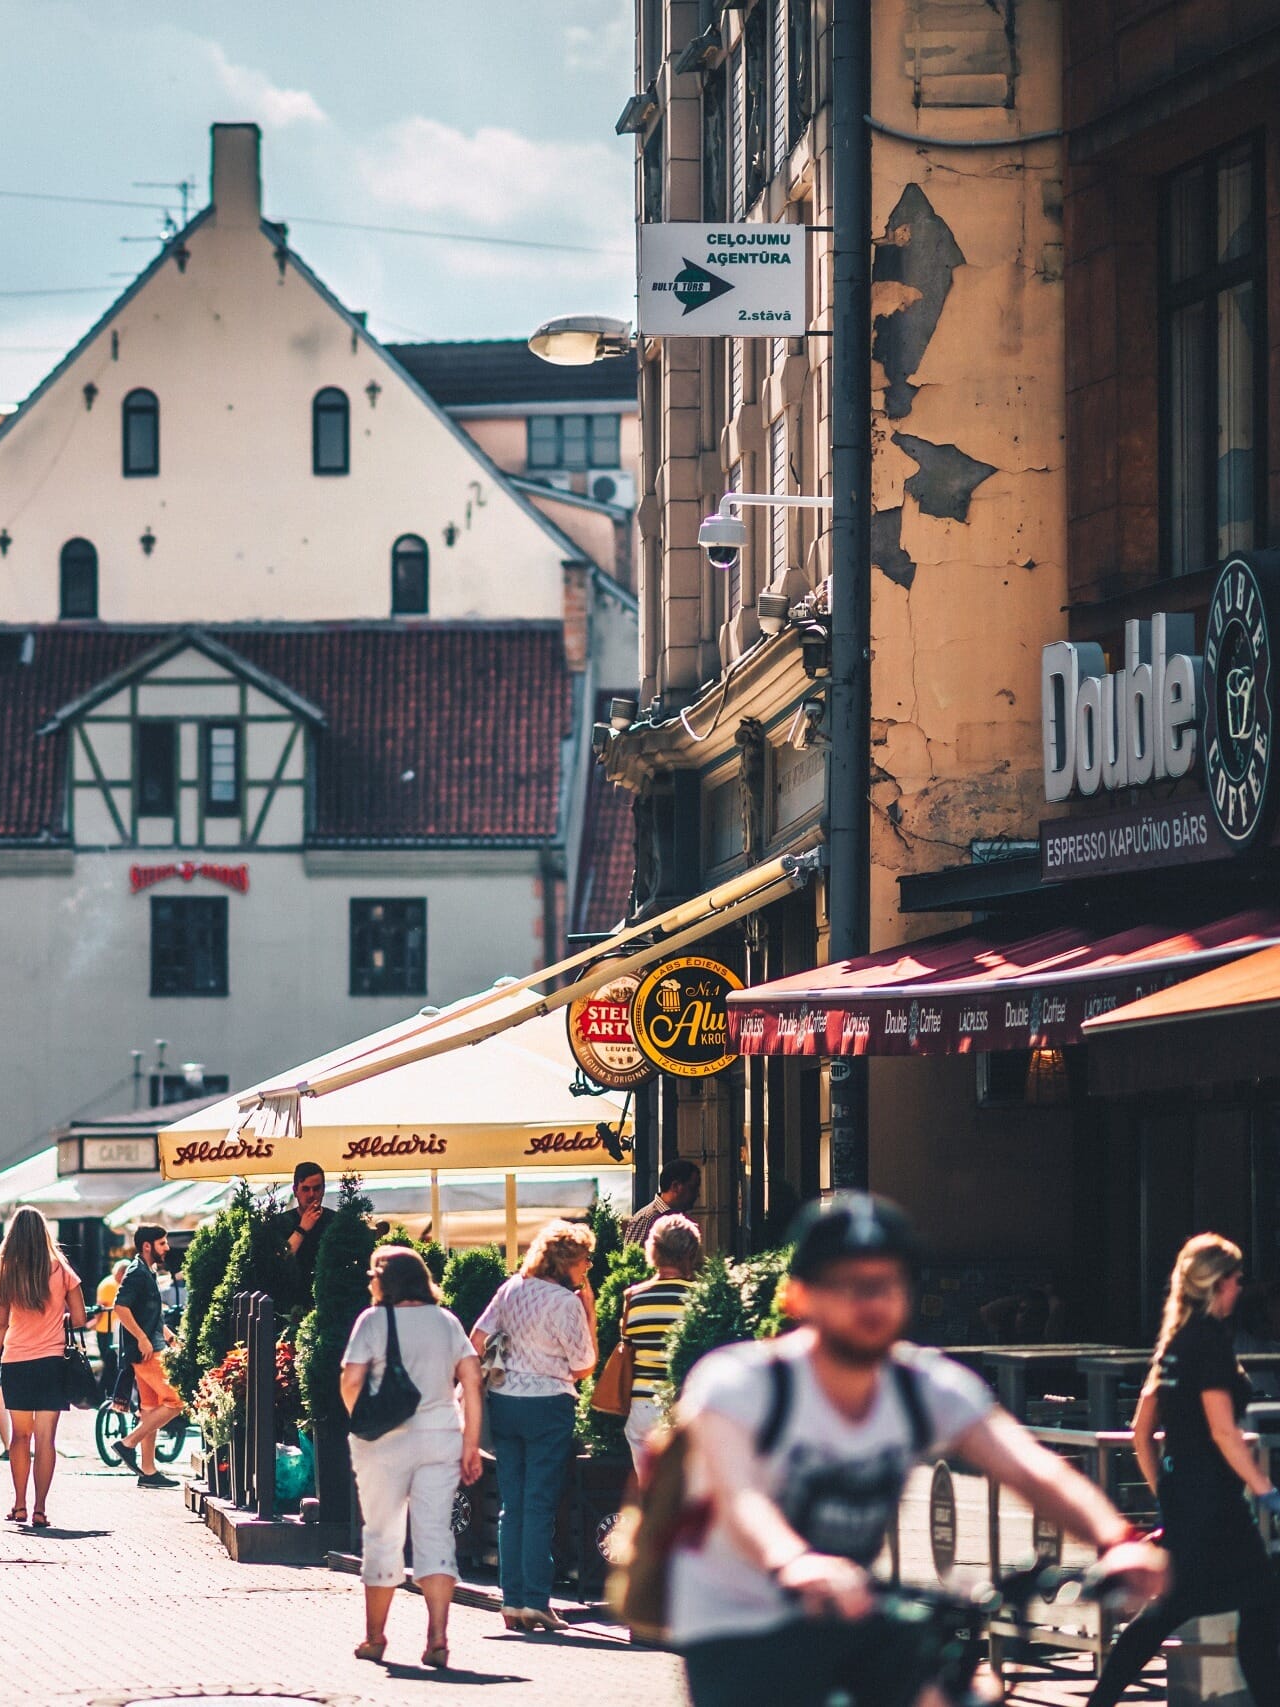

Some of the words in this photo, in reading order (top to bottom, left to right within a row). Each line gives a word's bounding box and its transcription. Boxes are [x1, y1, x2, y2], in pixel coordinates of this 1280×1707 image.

[706, 234, 791, 247] CEĻOJUMU
[706, 251, 791, 266] AĢENTŪRA
[652, 282, 678, 291] BULTA
[683, 281, 704, 291] TŪRS
[738, 310, 791, 321] 2.stāvā
[1207, 571, 1265, 673] DOUBLE
[1042, 612, 1196, 803] Double
[1208, 722, 1268, 827] COFFEE
[1047, 831, 1107, 867] ESPRESSO
[1109, 817, 1170, 858] KAPUČĪNO
[1173, 812, 1208, 847] BĀRS
[653, 961, 681, 980] LABS
[686, 957, 729, 977] ĒDIENS
[588, 1006, 629, 1020] STEL
[649, 1001, 726, 1049] Alu
[777, 1011, 797, 1035] Double
[884, 1009, 908, 1034] Double
[920, 1007, 942, 1033] Coffee
[1005, 1000, 1029, 1027] Double
[1042, 998, 1066, 1023] Coffee
[658, 1057, 697, 1075] IZCILS
[703, 1054, 733, 1073] ALUS
[173, 1138, 274, 1166] Aldaris
[342, 1133, 447, 1160] Aldaris
